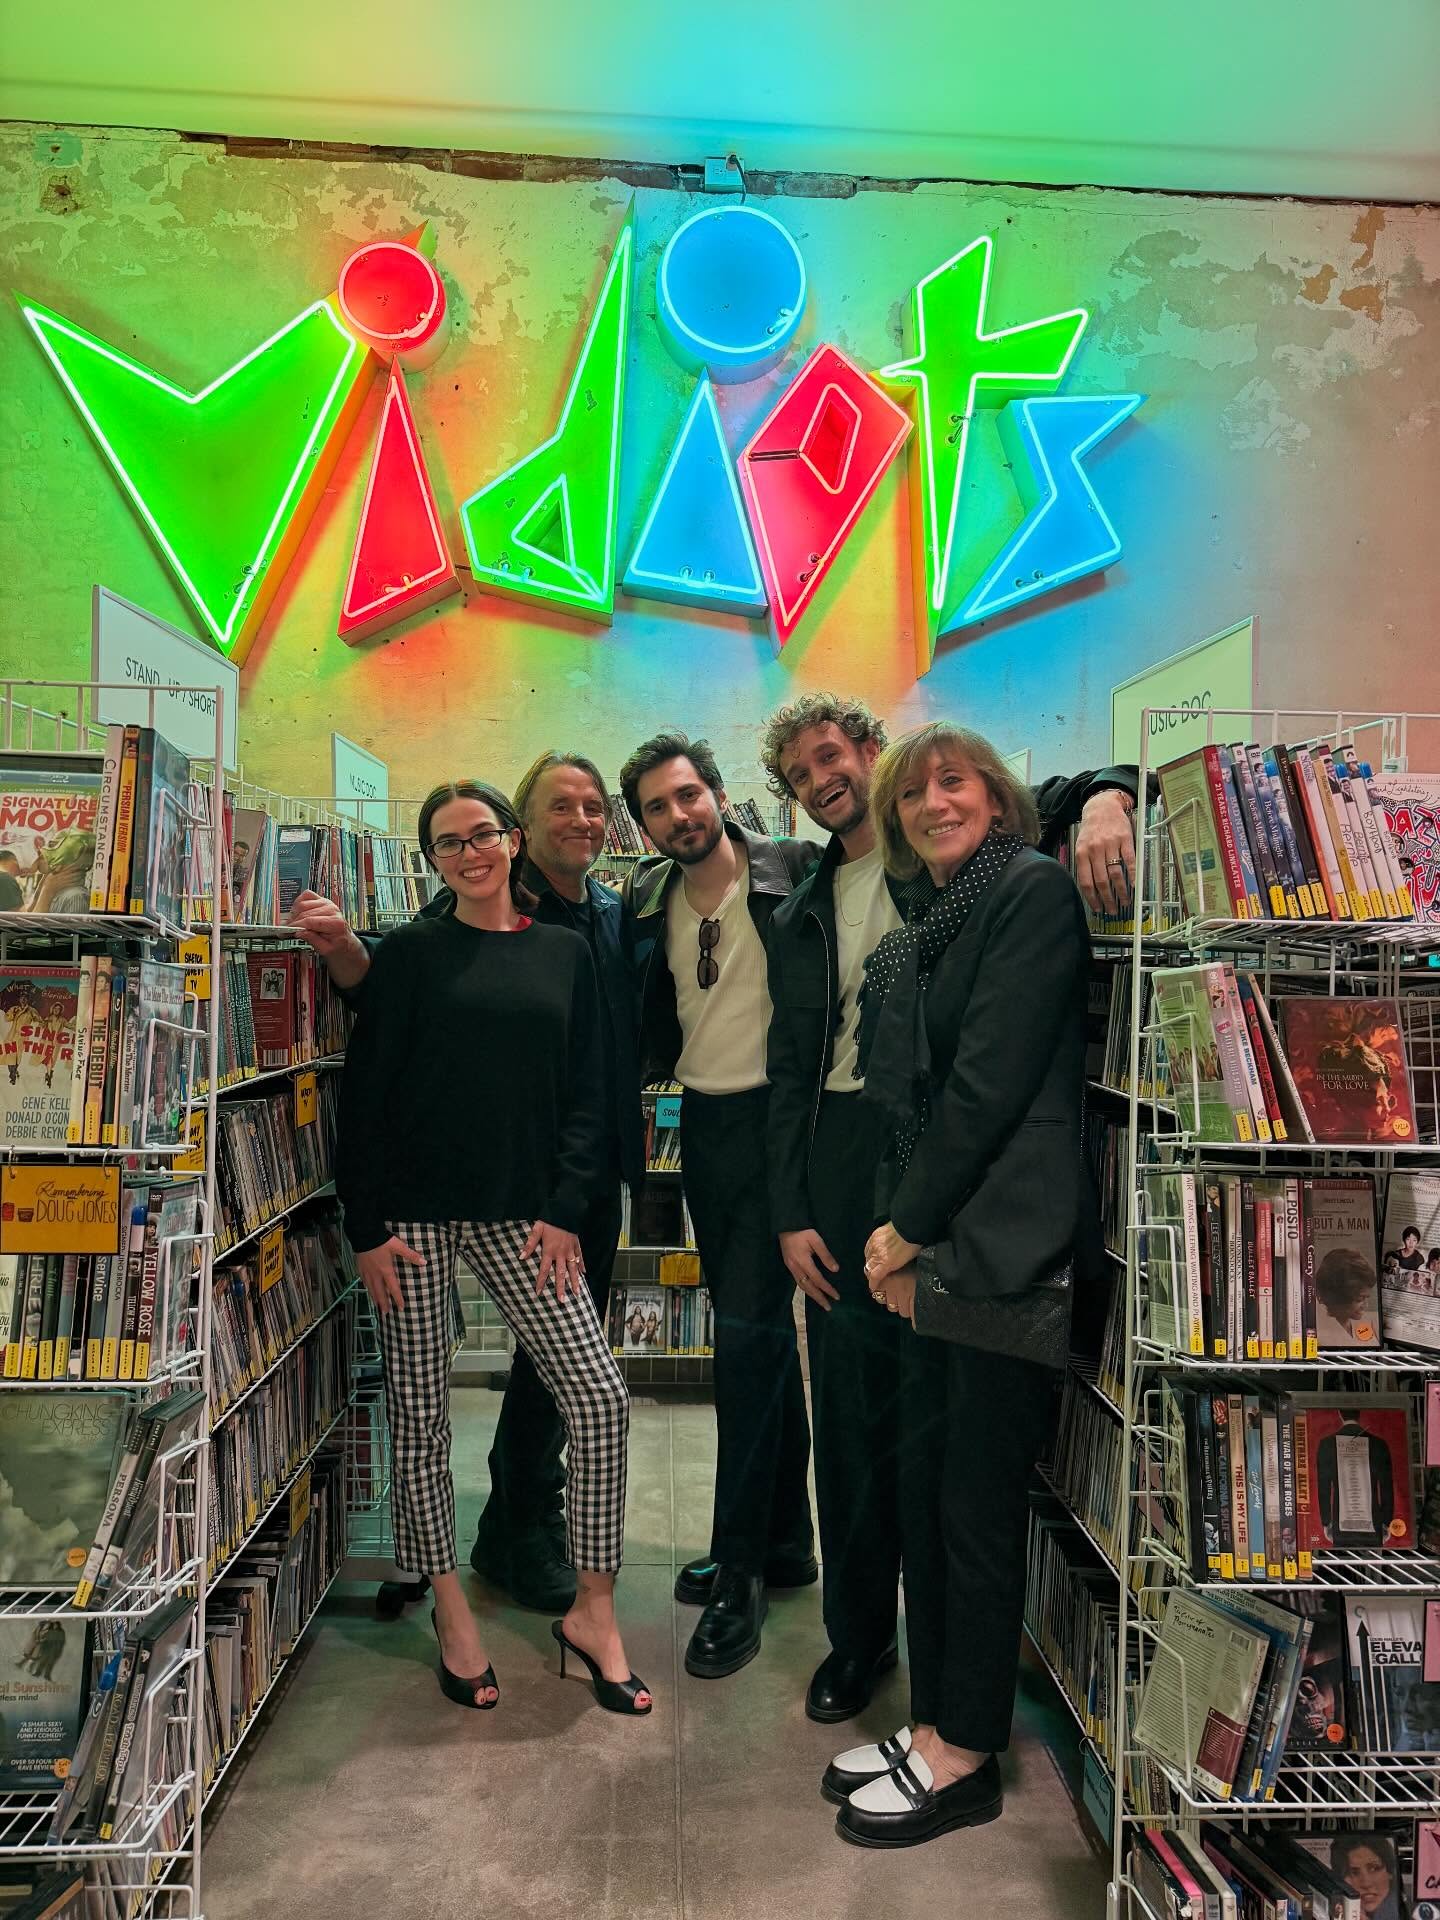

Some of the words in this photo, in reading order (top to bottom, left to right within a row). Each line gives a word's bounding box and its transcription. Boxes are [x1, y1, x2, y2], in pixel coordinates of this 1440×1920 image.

[125, 657, 160, 685] STAND
[1147, 705, 1177, 736] USIC
[1181, 690, 1211, 724] DOC
[2, 796, 99, 811] SIGNATURE
[95, 758, 117, 870] CIRCUMSTANCE
[120, 785, 133, 822] PERSIAN
[1263, 800, 1275, 824] Before
[0, 808, 95, 832] MOVE
[1247, 797, 1259, 820] Before
[1253, 821, 1268, 854] Midnight
[116, 822, 130, 853] VERSION
[1216, 792, 1226, 816] YEARS:
[1221, 818, 1232, 847] RICHARD
[1227, 849, 1240, 887] LINKLATER
[1234, 818, 1248, 846] NEWS
[1268, 824, 1284, 858] Midnight
[190, 979, 198, 990] TV
[92, 1018, 108, 1042] THE
[125, 1035, 133, 1052] More
[88, 1044, 106, 1089] DEBUT
[1243, 1047, 1257, 1085] BECKHAM
[1323, 1081, 1342, 1090] FOR
[1345, 1081, 1369, 1090] LOVE
[22, 1096, 46, 1110] GENE
[49, 1097, 70, 1110] KELL
[6, 1111, 42, 1125] DONALD
[44, 1111, 70, 1125] O'CON
[6, 1125, 37, 1139] DEBBIE
[36, 1181, 109, 1199] Remembering
[1285, 1185, 1295, 1195] IL
[36, 1200, 76, 1223] DOUG
[77, 1201, 118, 1223] JONES
[1285, 1200, 1297, 1239] POSTO
[1314, 1217, 1334, 1230] BUT
[1337, 1217, 1344, 1230] A
[1347, 1217, 1370, 1230] MAN
[1303, 1244, 1315, 1277] Gerry
[92, 1256, 107, 1302] service
[114, 1272, 123, 1300] BROCKA
[141, 1251, 157, 1299] YELLOW
[1190, 1261, 1198, 1291] WAITING
[1247, 1271, 1255, 1298] BALLET
[137, 1305, 151, 1336] ROSE
[1, 1403, 112, 1420] CHUNGKING
[41, 1418, 111, 1436] EXPRESS
[1282, 1424, 1290, 1438] THE
[1282, 1440, 1290, 1458] WAR
[1234, 1464, 1244, 1487] THIS
[1283, 1461, 1290, 1470] OF
[1283, 1473, 1291, 1488] THE
[102, 1472, 126, 1528] PERSONA
[1236, 1502, 1244, 1518] MY
[1283, 1490, 1292, 1516] ROSES
[1221, 1507, 1229, 1530] SPLIT
[1237, 1521, 1246, 1543] LIFE
[1370, 1641, 1423, 1653] ELEVA
[1375, 1653, 1422, 1665] GALL
[18, 1693, 39, 1702] mind
